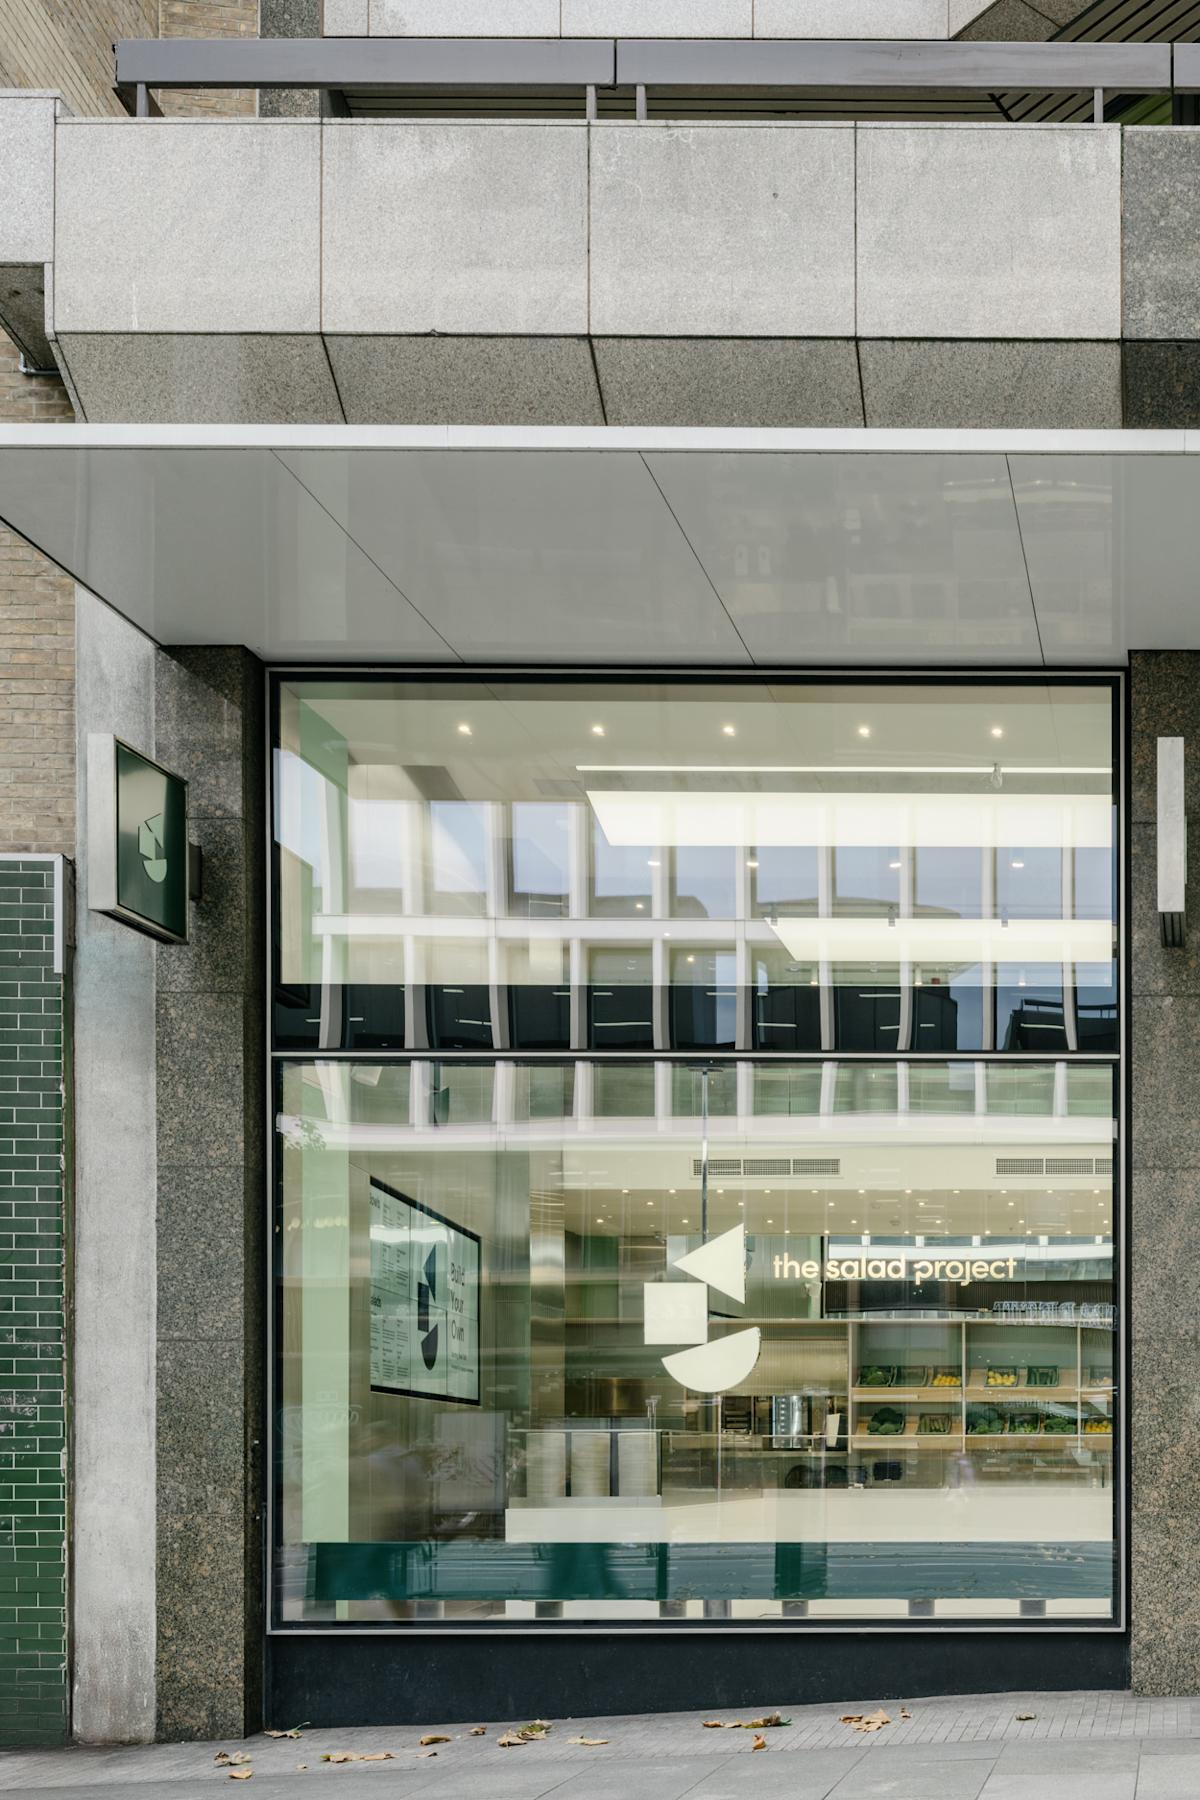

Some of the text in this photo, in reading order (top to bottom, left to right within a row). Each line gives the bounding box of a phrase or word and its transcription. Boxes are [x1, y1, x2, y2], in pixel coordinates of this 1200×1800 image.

[773, 1252, 1017, 1286] the salad project
